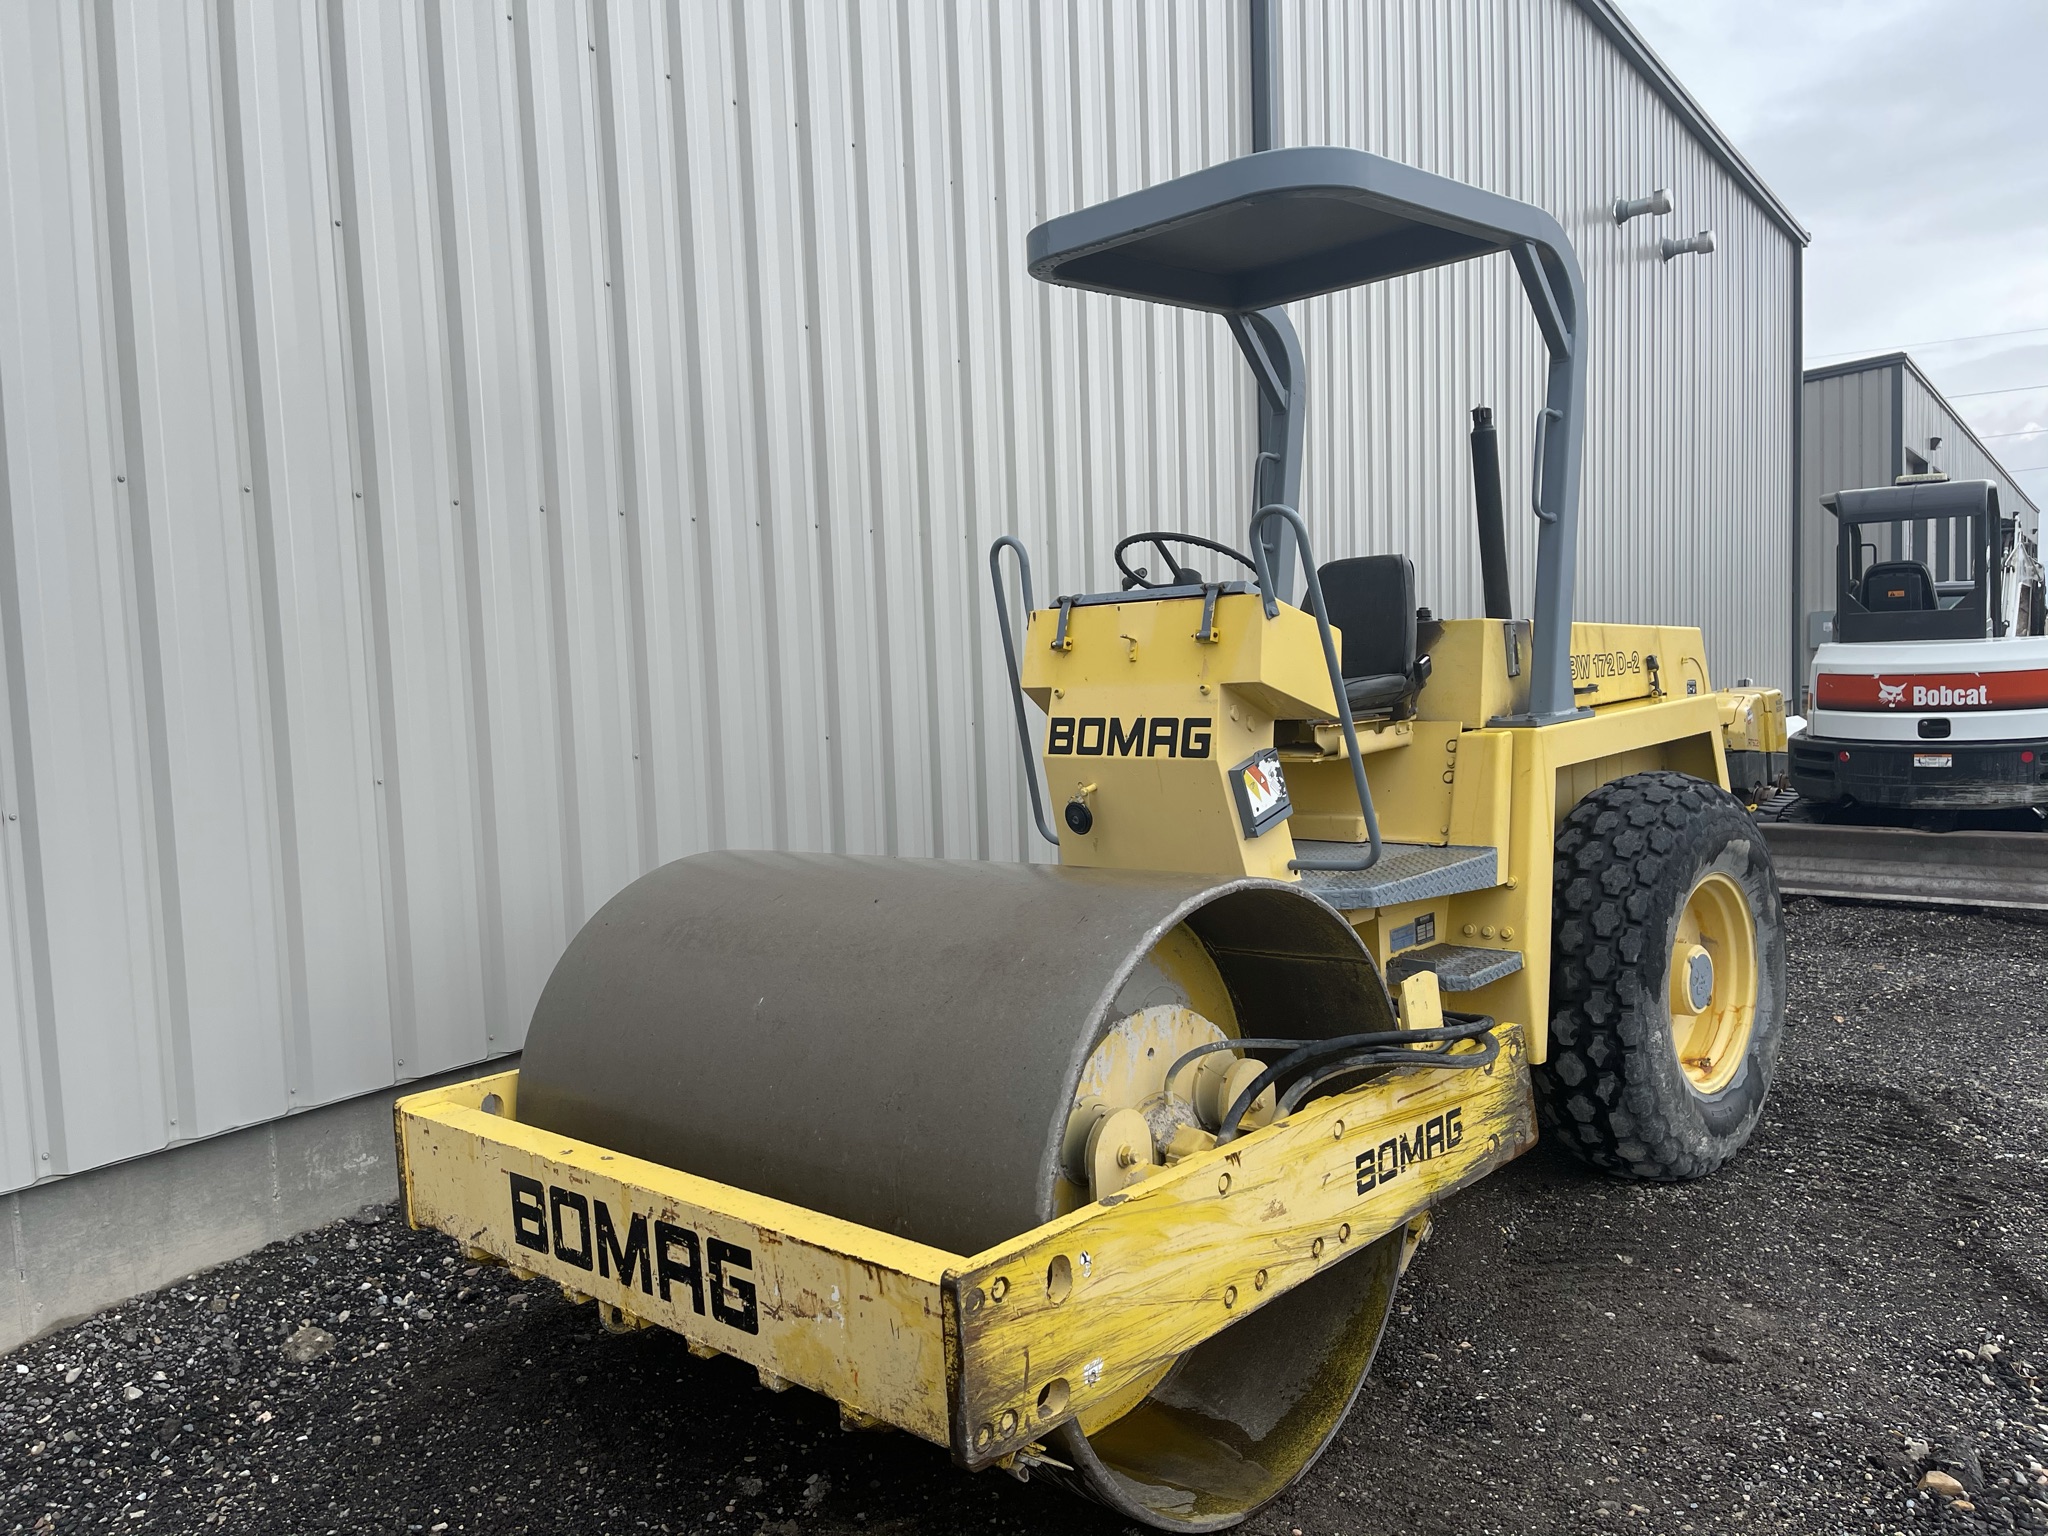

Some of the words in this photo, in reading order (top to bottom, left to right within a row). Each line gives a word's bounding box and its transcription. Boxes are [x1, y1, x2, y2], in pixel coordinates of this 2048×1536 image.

[1593, 653, 1615, 678] 172
[1616, 651, 1640, 676] D-2
[1913, 685, 1987, 706] Bobcat
[1048, 717, 1212, 758] BOMAG
[1356, 1107, 1463, 1196] BOMAG
[510, 1171, 759, 1336] BOMAG
